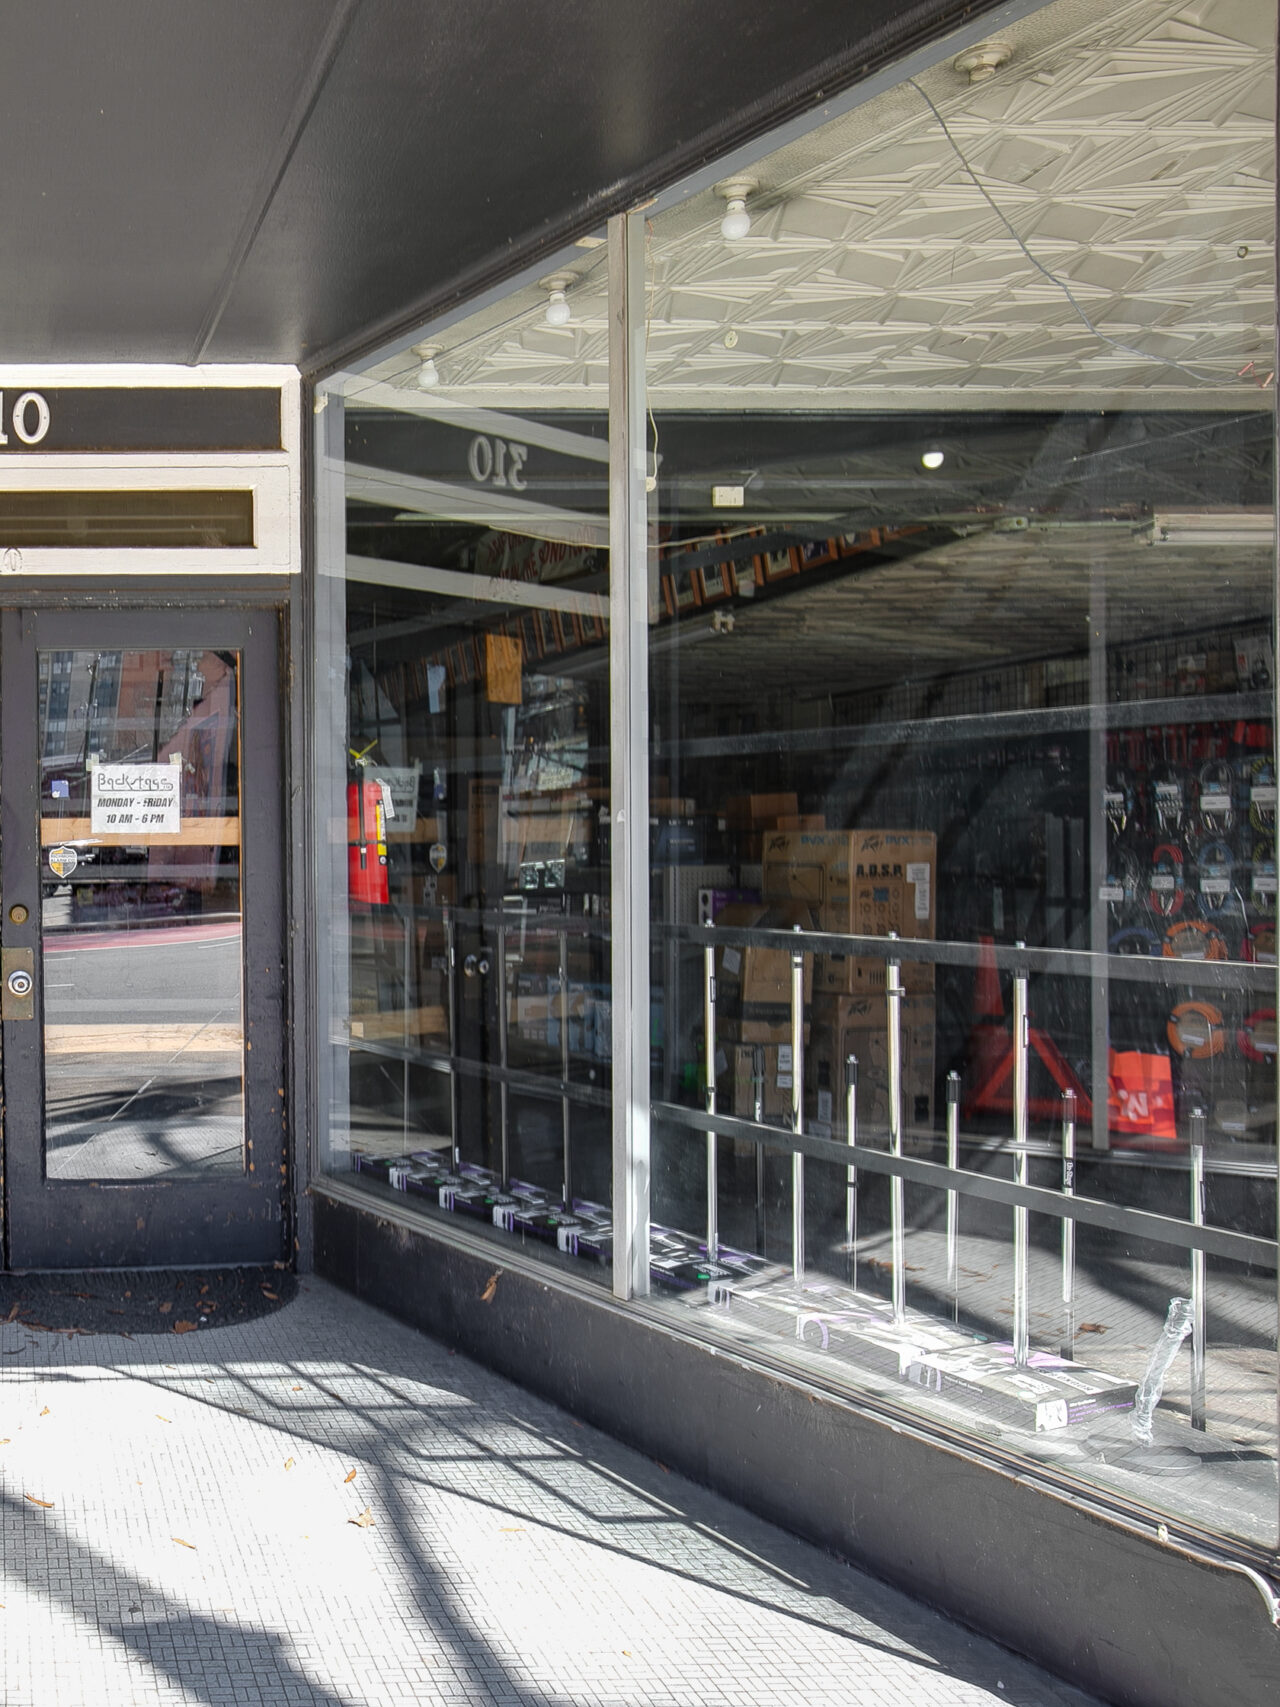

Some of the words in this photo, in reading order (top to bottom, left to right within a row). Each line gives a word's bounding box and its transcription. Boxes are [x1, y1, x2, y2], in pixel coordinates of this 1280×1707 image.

[97, 797, 135, 808] MONDAY
[106, 814, 117, 824] 10
[118, 814, 133, 824] AM
[141, 814, 148, 824] 6
[149, 814, 165, 824] PM
